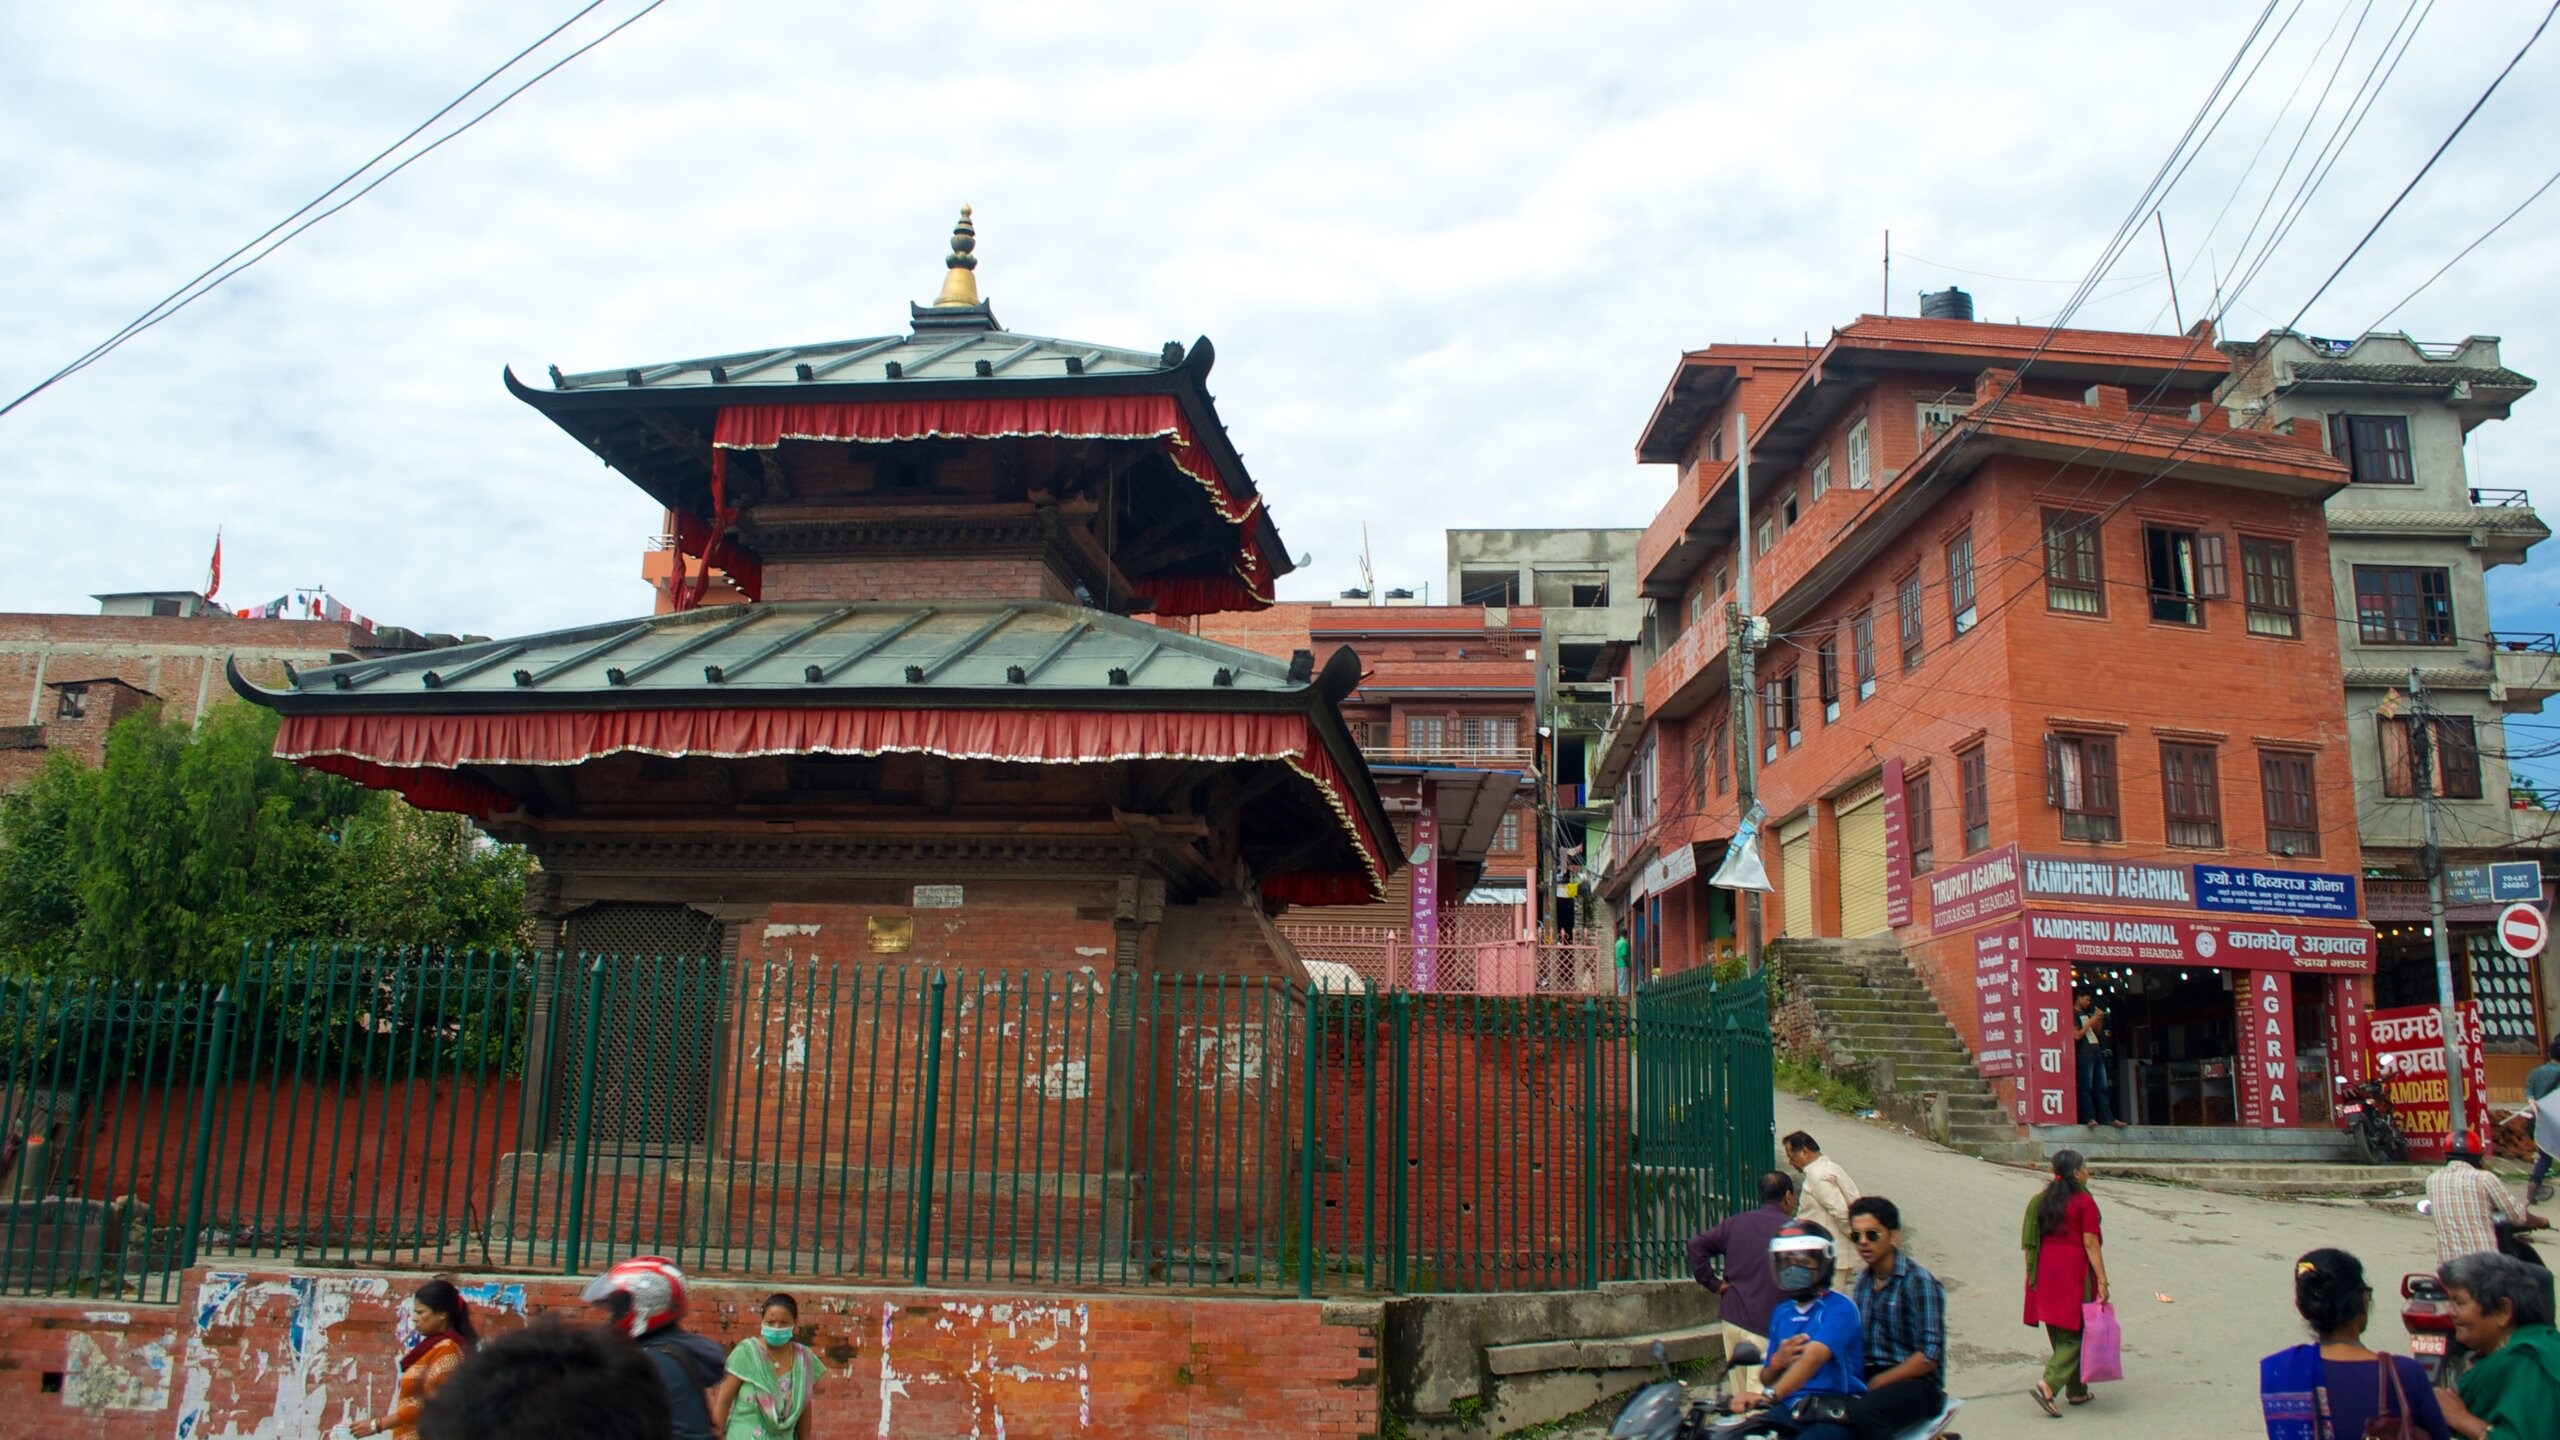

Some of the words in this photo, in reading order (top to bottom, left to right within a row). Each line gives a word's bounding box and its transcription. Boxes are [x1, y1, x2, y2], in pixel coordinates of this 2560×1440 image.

[1932, 871, 1970, 906] TIRUPATI
[1971, 855, 2016, 894] AGARWAL
[2026, 860, 2114, 897] KAMDHENU
[2117, 866, 2190, 902] AGARWAL
[2253, 872, 2306, 890] दिव्यराज
[2502, 875, 2528, 883] TO-LET
[1934, 902, 1976, 928] RUDRAKSHA
[1979, 889, 2016, 914] BHANDAR
[2032, 917, 2110, 942] KAMDHENU
[2114, 923, 2179, 945] AGARWAL
[2302, 935, 2367, 956] अग्रवाल
[2076, 944, 2134, 957] RUDRAKSHA
[2139, 947, 2184, 960] BHANDAR
[2036, 967, 2064, 1116] अग्रवाल
[2262, 974, 2286, 1124] AGARWAL
[2469, 1007, 2491, 1148] AGARWAL
